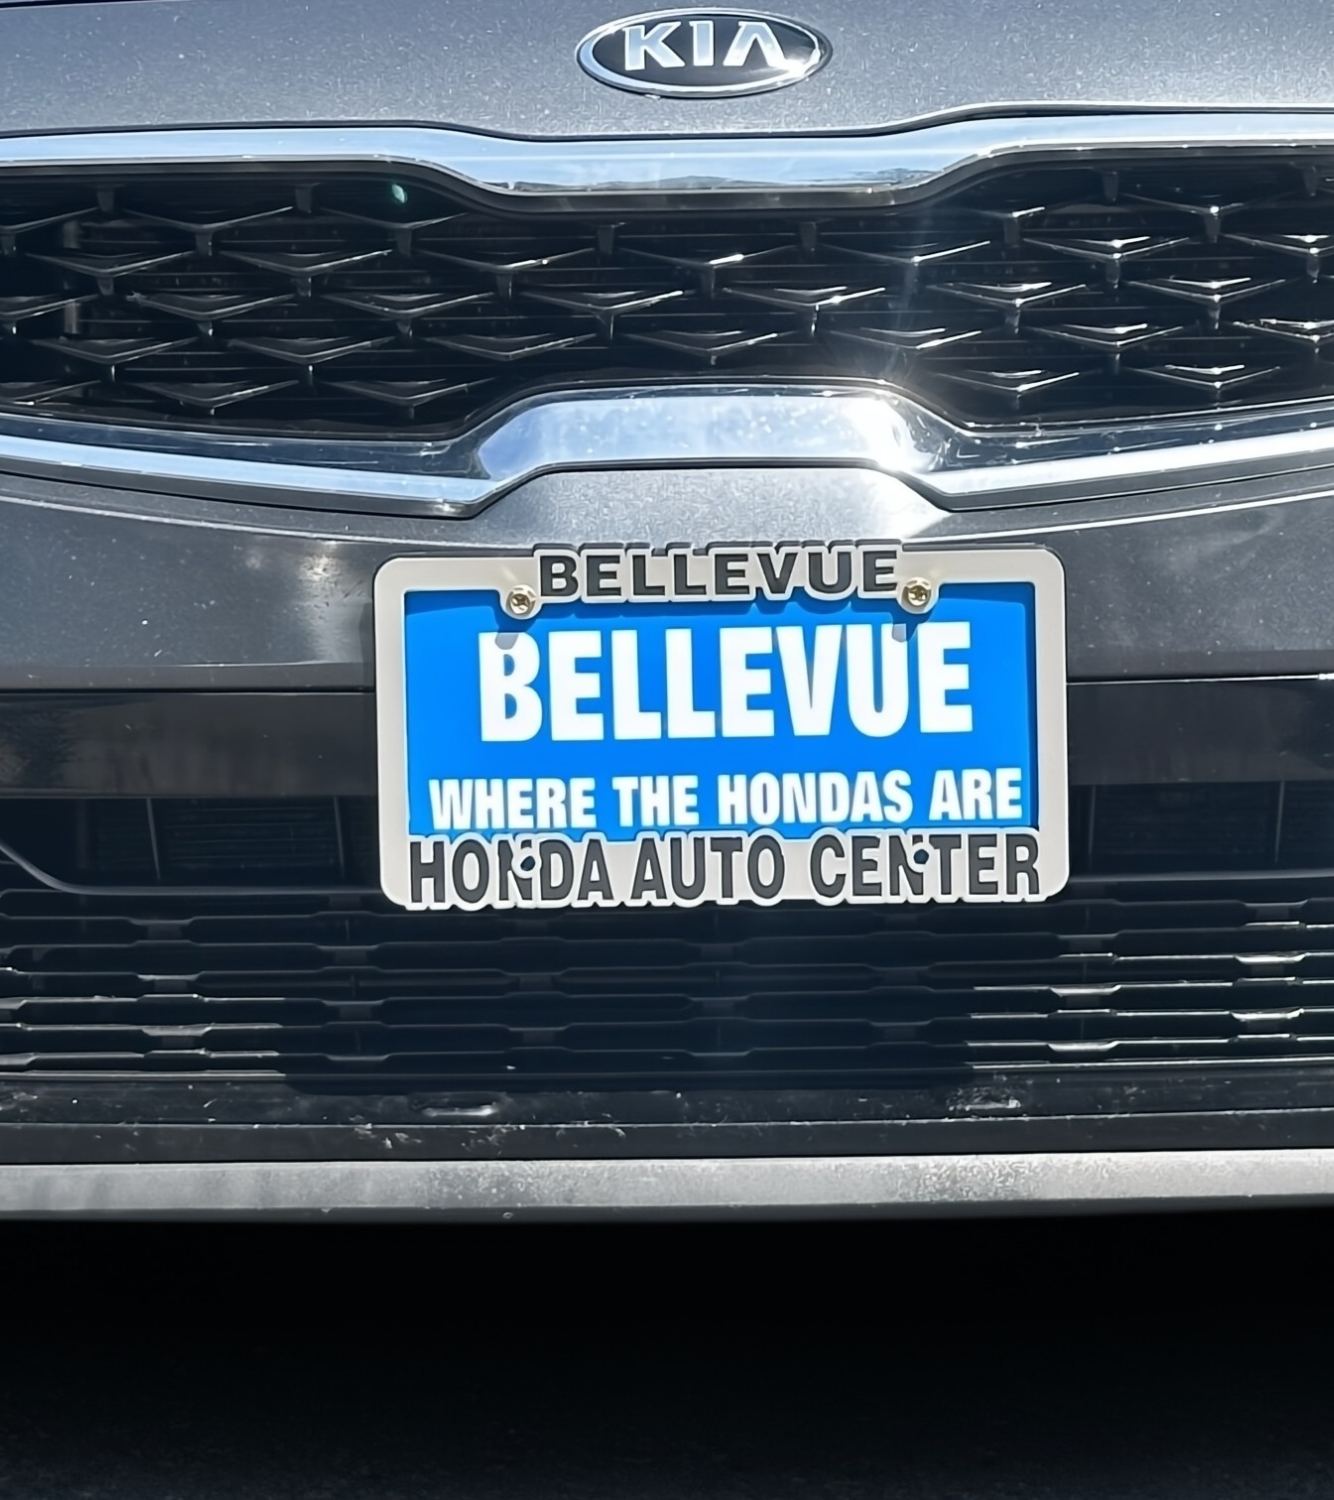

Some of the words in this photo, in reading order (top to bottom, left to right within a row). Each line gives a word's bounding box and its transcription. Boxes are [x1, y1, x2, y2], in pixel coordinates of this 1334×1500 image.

[622, 20, 787, 71] KIA
[539, 549, 899, 597] BELLEVUE
[477, 621, 974, 742] BELLEVUE
[428, 778, 596, 831] WHERE
[612, 774, 699, 828] THE
[717, 769, 914, 826] HONDAS
[928, 766, 1023, 821] ARE
[409, 838, 615, 904] HONDA
[630, 836, 786, 900] AUTO
[809, 833, 1040, 898] CENTER
